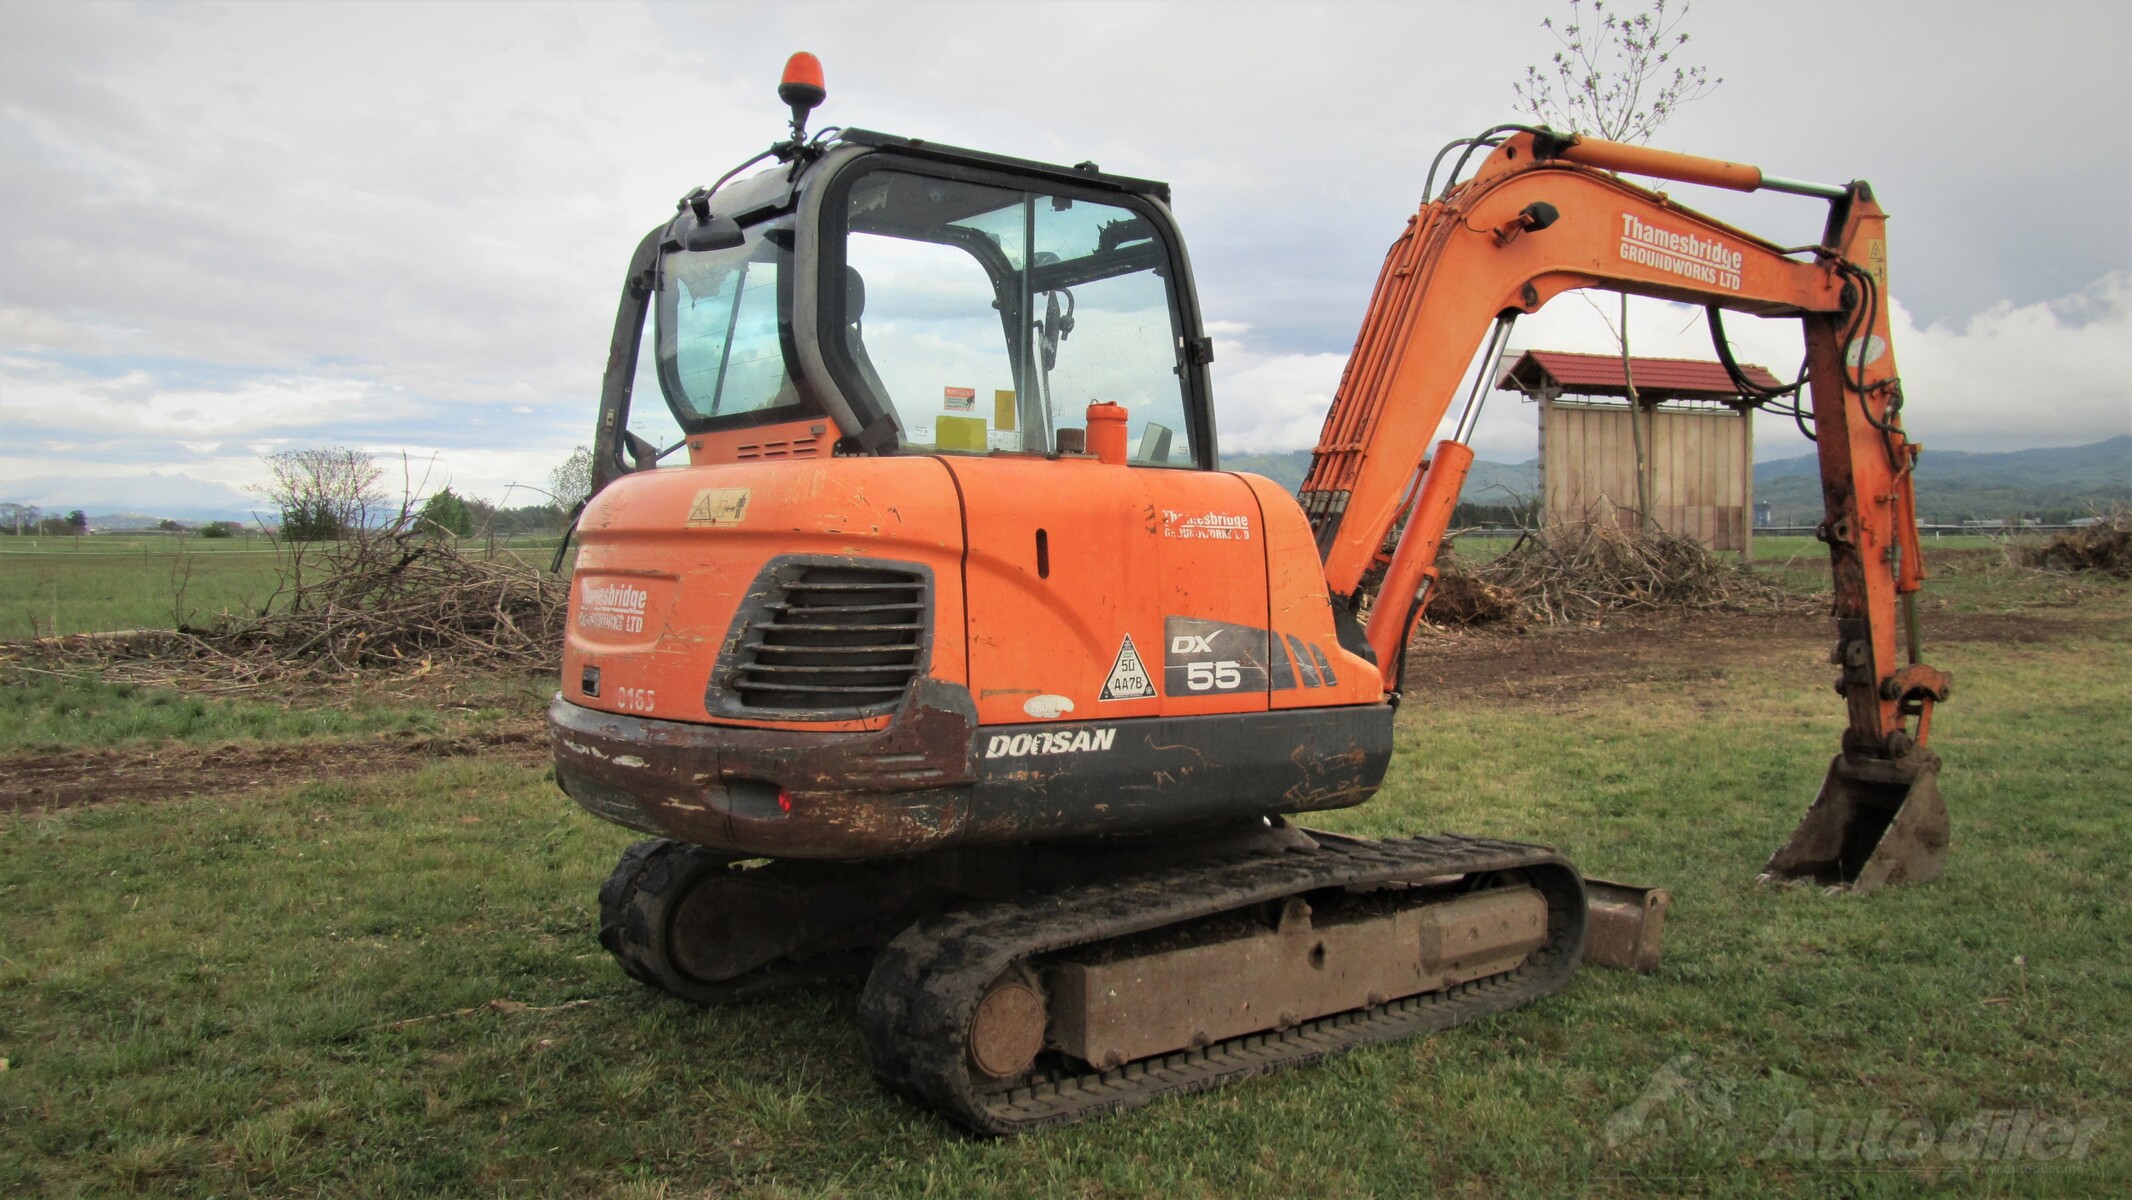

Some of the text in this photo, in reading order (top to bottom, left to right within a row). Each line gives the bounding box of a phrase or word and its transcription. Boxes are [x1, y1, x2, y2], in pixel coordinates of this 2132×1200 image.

[1622, 213, 1742, 269] Thamesbridge
[1620, 243, 1740, 290] GROUNDWORKS LTD
[626, 616, 643, 633] LTD
[1171, 629, 1223, 653] DX
[1187, 661, 1241, 690] 55
[617, 687, 655, 712] 0165
[985, 728, 1117, 759] DOOSAN
